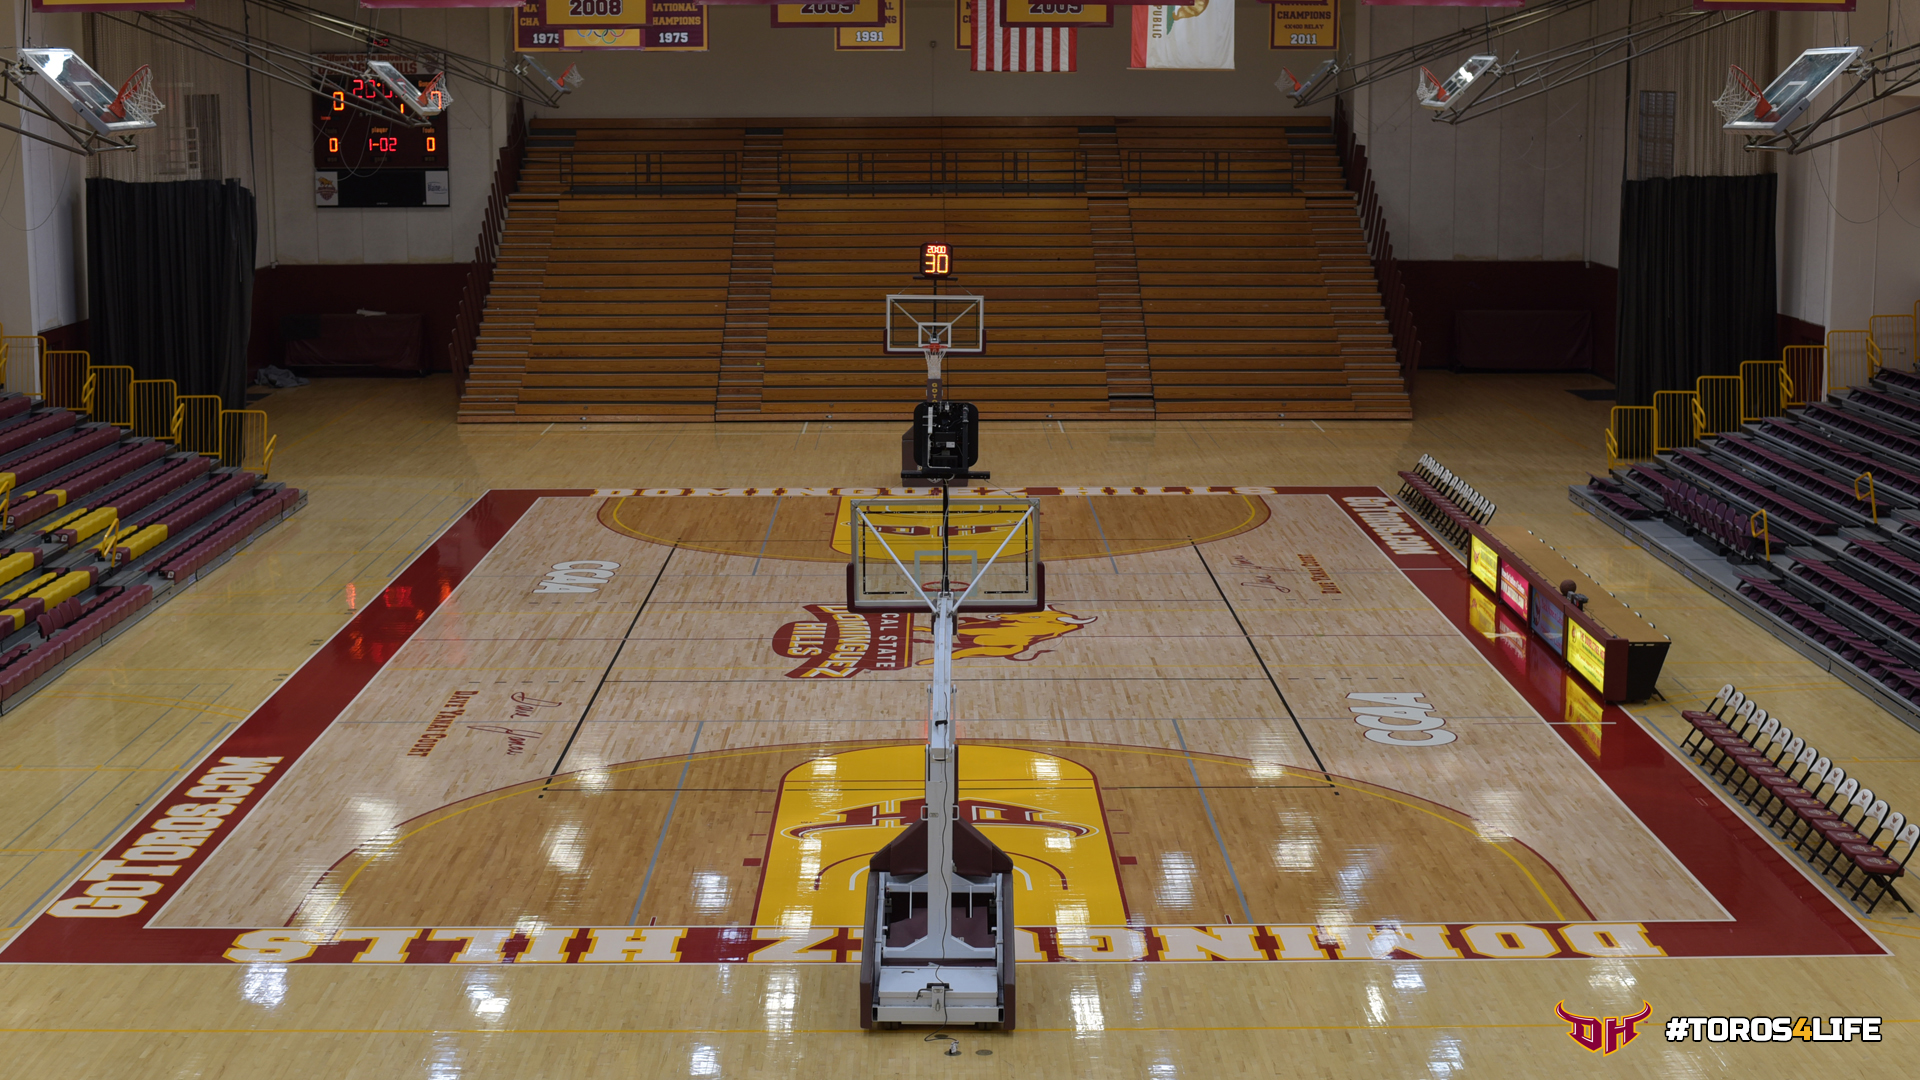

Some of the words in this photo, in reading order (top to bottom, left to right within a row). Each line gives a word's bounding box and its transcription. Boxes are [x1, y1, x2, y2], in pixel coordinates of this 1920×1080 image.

[569, 0, 623, 16] 2008
[1277, 11, 1331, 19] CHAMPIONS
[653, 16, 701, 25] HAMPIONS
[1152, 5, 1162, 38] PUBLIC
[659, 33, 688, 43] 1975
[856, 31, 884, 42] 1991
[1290, 34, 1317, 45] 2011
[332, 91, 345, 111] 0
[329, 137, 338, 153] 0
[426, 136, 436, 152] 0
[927, 245, 947, 254] 20:00
[925, 253, 949, 274] 30
[1341, 496, 1439, 555] GOTOROS.COM
[532, 560, 621, 594] CCAA
[880, 613, 900, 631] CAL
[787, 623, 828, 656] HILLS
[876, 635, 898, 668] STATE
[443, 690, 480, 708] DAVE
[425, 709, 466, 732] YANAI
[1345, 692, 1458, 747] CCAA
[406, 733, 448, 757] COURT
[46, 756, 285, 918] GOTOROS.COM
[222, 928, 688, 963] HILLS
[748, 922, 1668, 964] DOMINGZ
